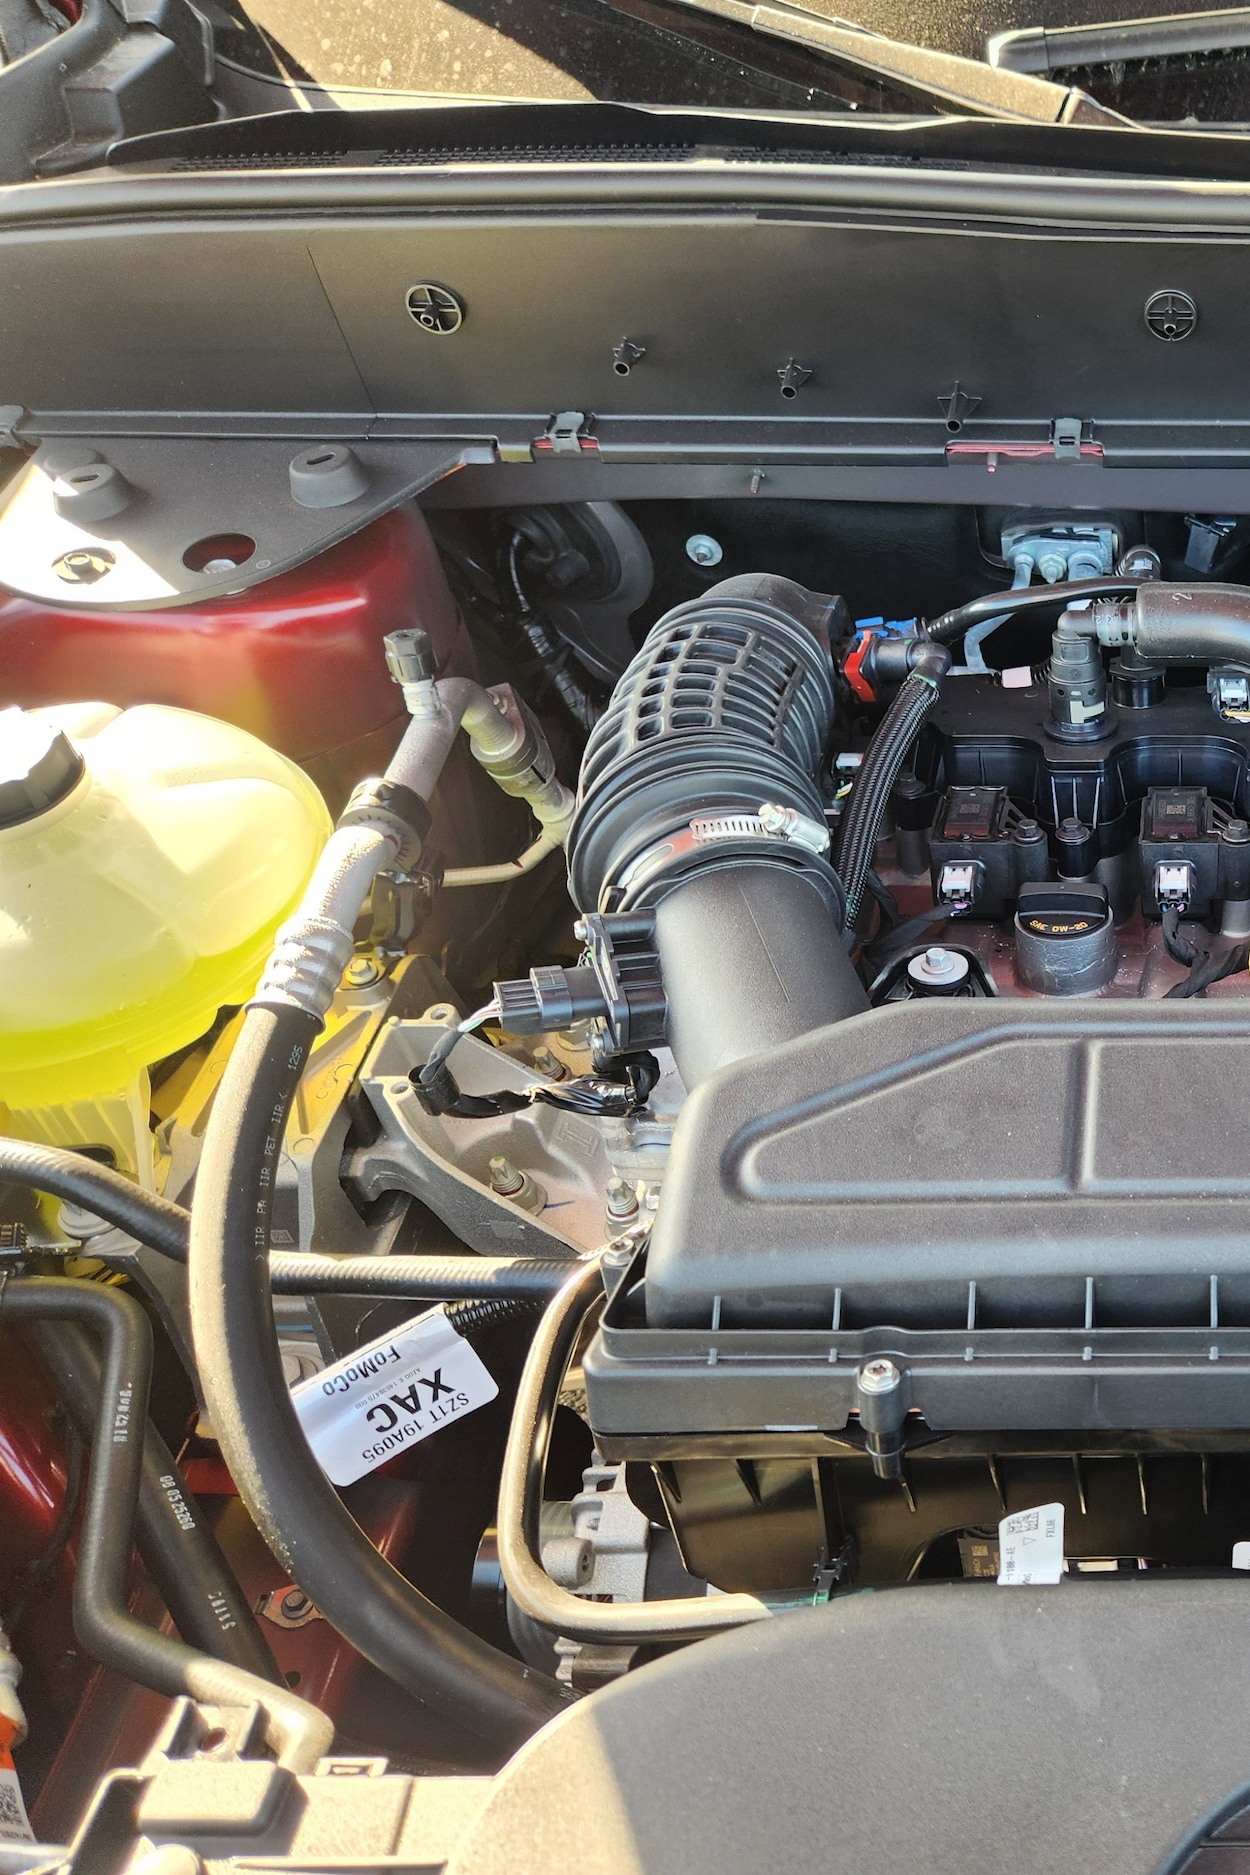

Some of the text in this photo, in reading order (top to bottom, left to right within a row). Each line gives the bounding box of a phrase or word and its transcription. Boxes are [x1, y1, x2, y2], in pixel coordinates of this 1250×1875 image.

[1029, 919, 1088, 933] SAE 0W-20
[264, 1135, 276, 1156] PET
[288, 1045, 303, 1070] 1295
[322, 1344, 402, 1396] FoMoCo
[366, 1367, 456, 1434] XAC
[362, 1392, 469, 1463] SZ1T 19A095
